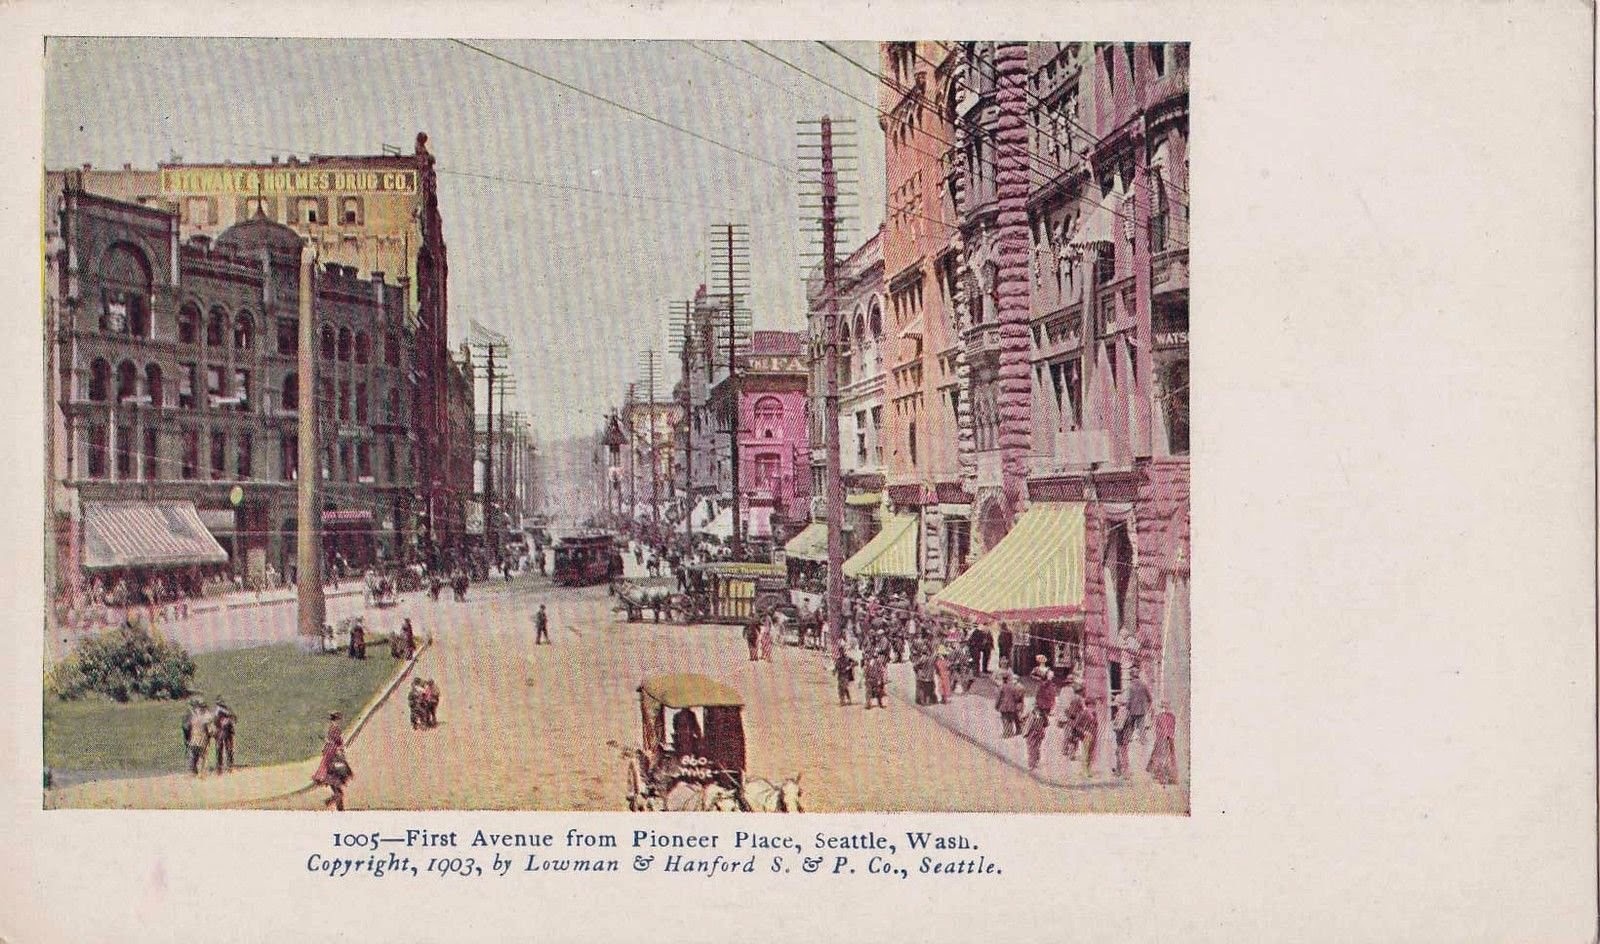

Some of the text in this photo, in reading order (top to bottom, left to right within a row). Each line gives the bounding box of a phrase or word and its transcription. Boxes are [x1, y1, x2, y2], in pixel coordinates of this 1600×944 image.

[264, 170, 329, 190] HOLMES
[335, 171, 377, 191] DRUG
[383, 171, 412, 191] CO.
[1155, 332, 1188, 345] WATS
